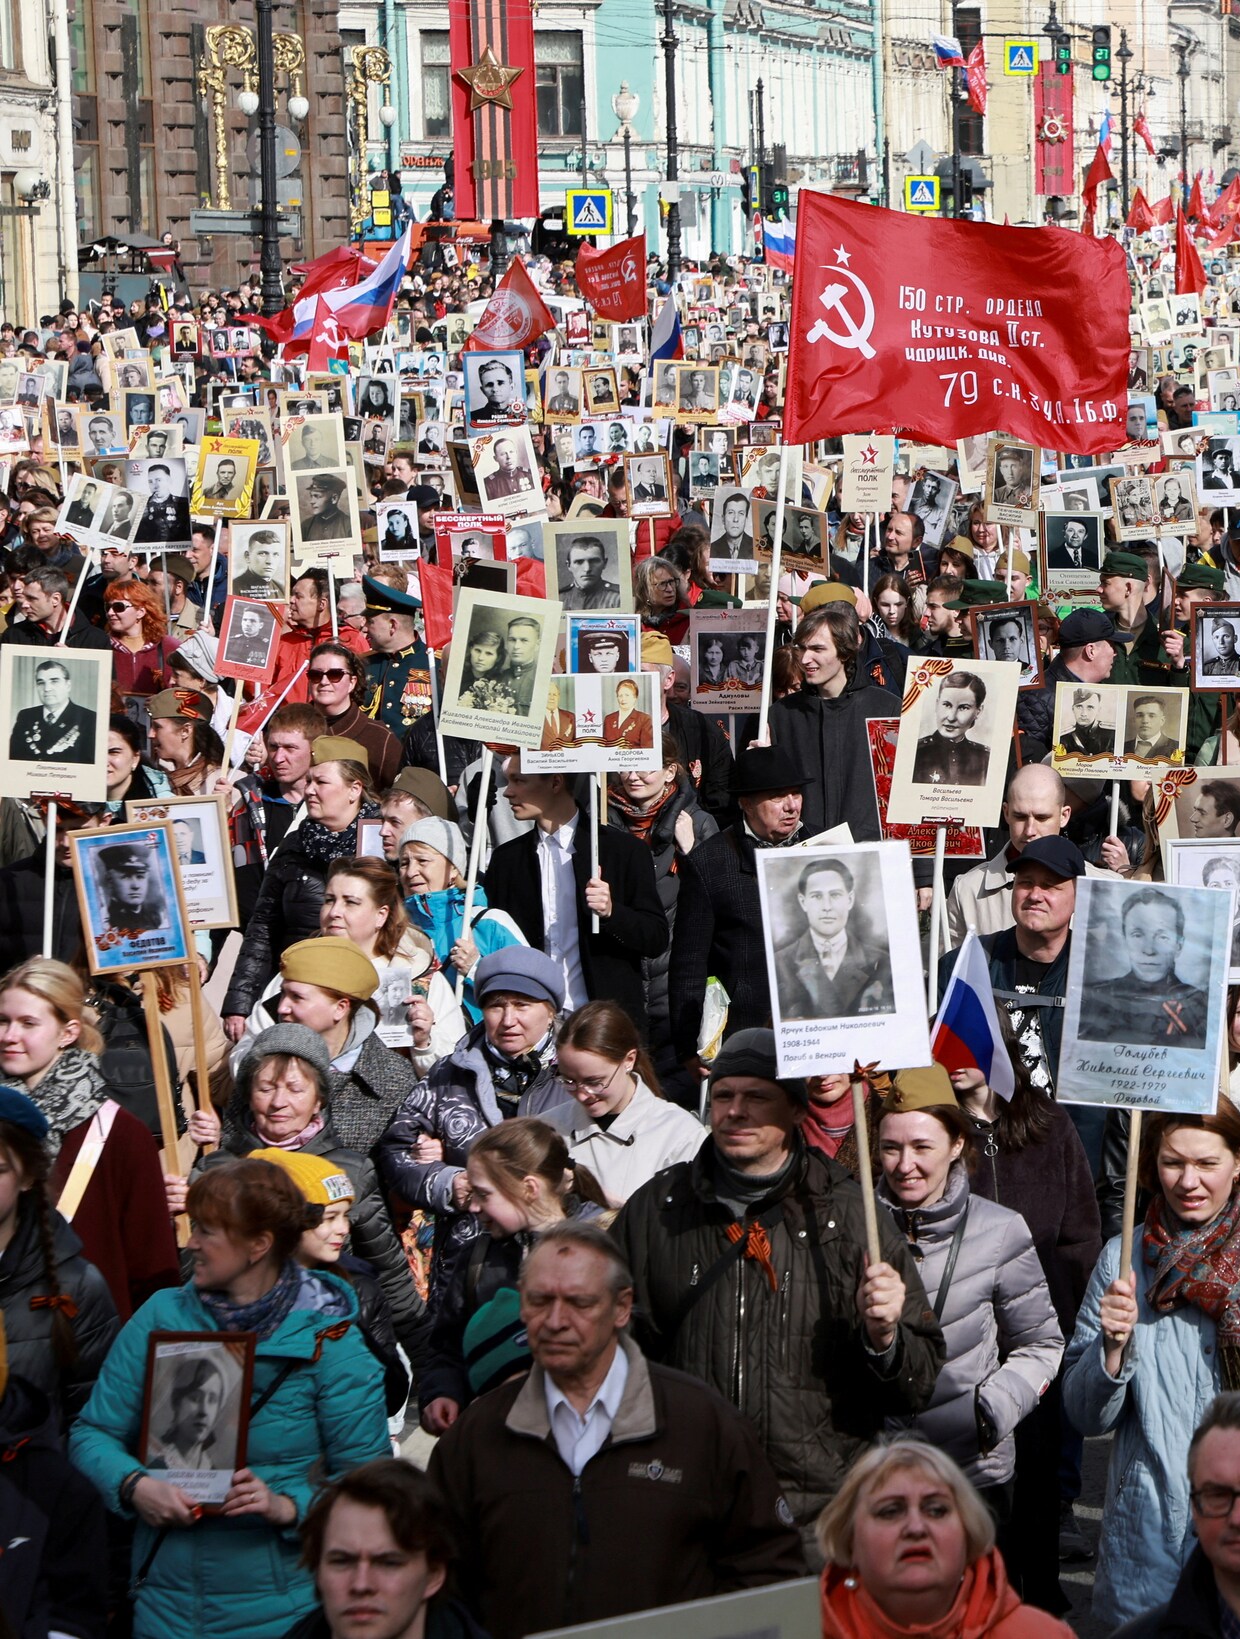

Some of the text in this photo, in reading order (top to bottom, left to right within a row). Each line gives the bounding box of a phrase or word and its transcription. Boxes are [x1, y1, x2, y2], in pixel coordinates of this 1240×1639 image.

[1059, 49, 1069, 59] 31
[1096, 49, 1109, 60] 27
[774, 191, 786, 202] 31
[899, 285, 926, 311] 150
[985, 297, 1043, 317] ОРДЕНА
[938, 370, 979, 408] 79
[857, 474, 878, 482] ПОЛК
[436, 514, 504, 522] БЕССМЕРТНЫЙ
[442, 710, 542, 731] Жигалова Александра Ивановна
[474, 722, 501, 734] Николай
[501, 725, 541, 738] Михайлович
[932, 787, 963, 795] Васильева
[919, 794, 974, 803] Тамара Васильевна
[907, 826, 960, 838] Алексдр
[129, 937, 166, 948] ФЕДОТОВ
[781, 1020, 887, 1037] Ярчук Евдоким Николаевич
[782, 1038, 821, 1048] 1908-1944
[783, 1053, 808, 1062] Погиб
[816, 1051, 847, 1060] Венгрии
[1113, 1045, 1169, 1061] Голубев
[1076, 1058, 1207, 1081] Николай Сергеевич
[1110, 1079, 1167, 1091] 1922-1979
[1113, 1089, 1162, 1105] Рядовой
